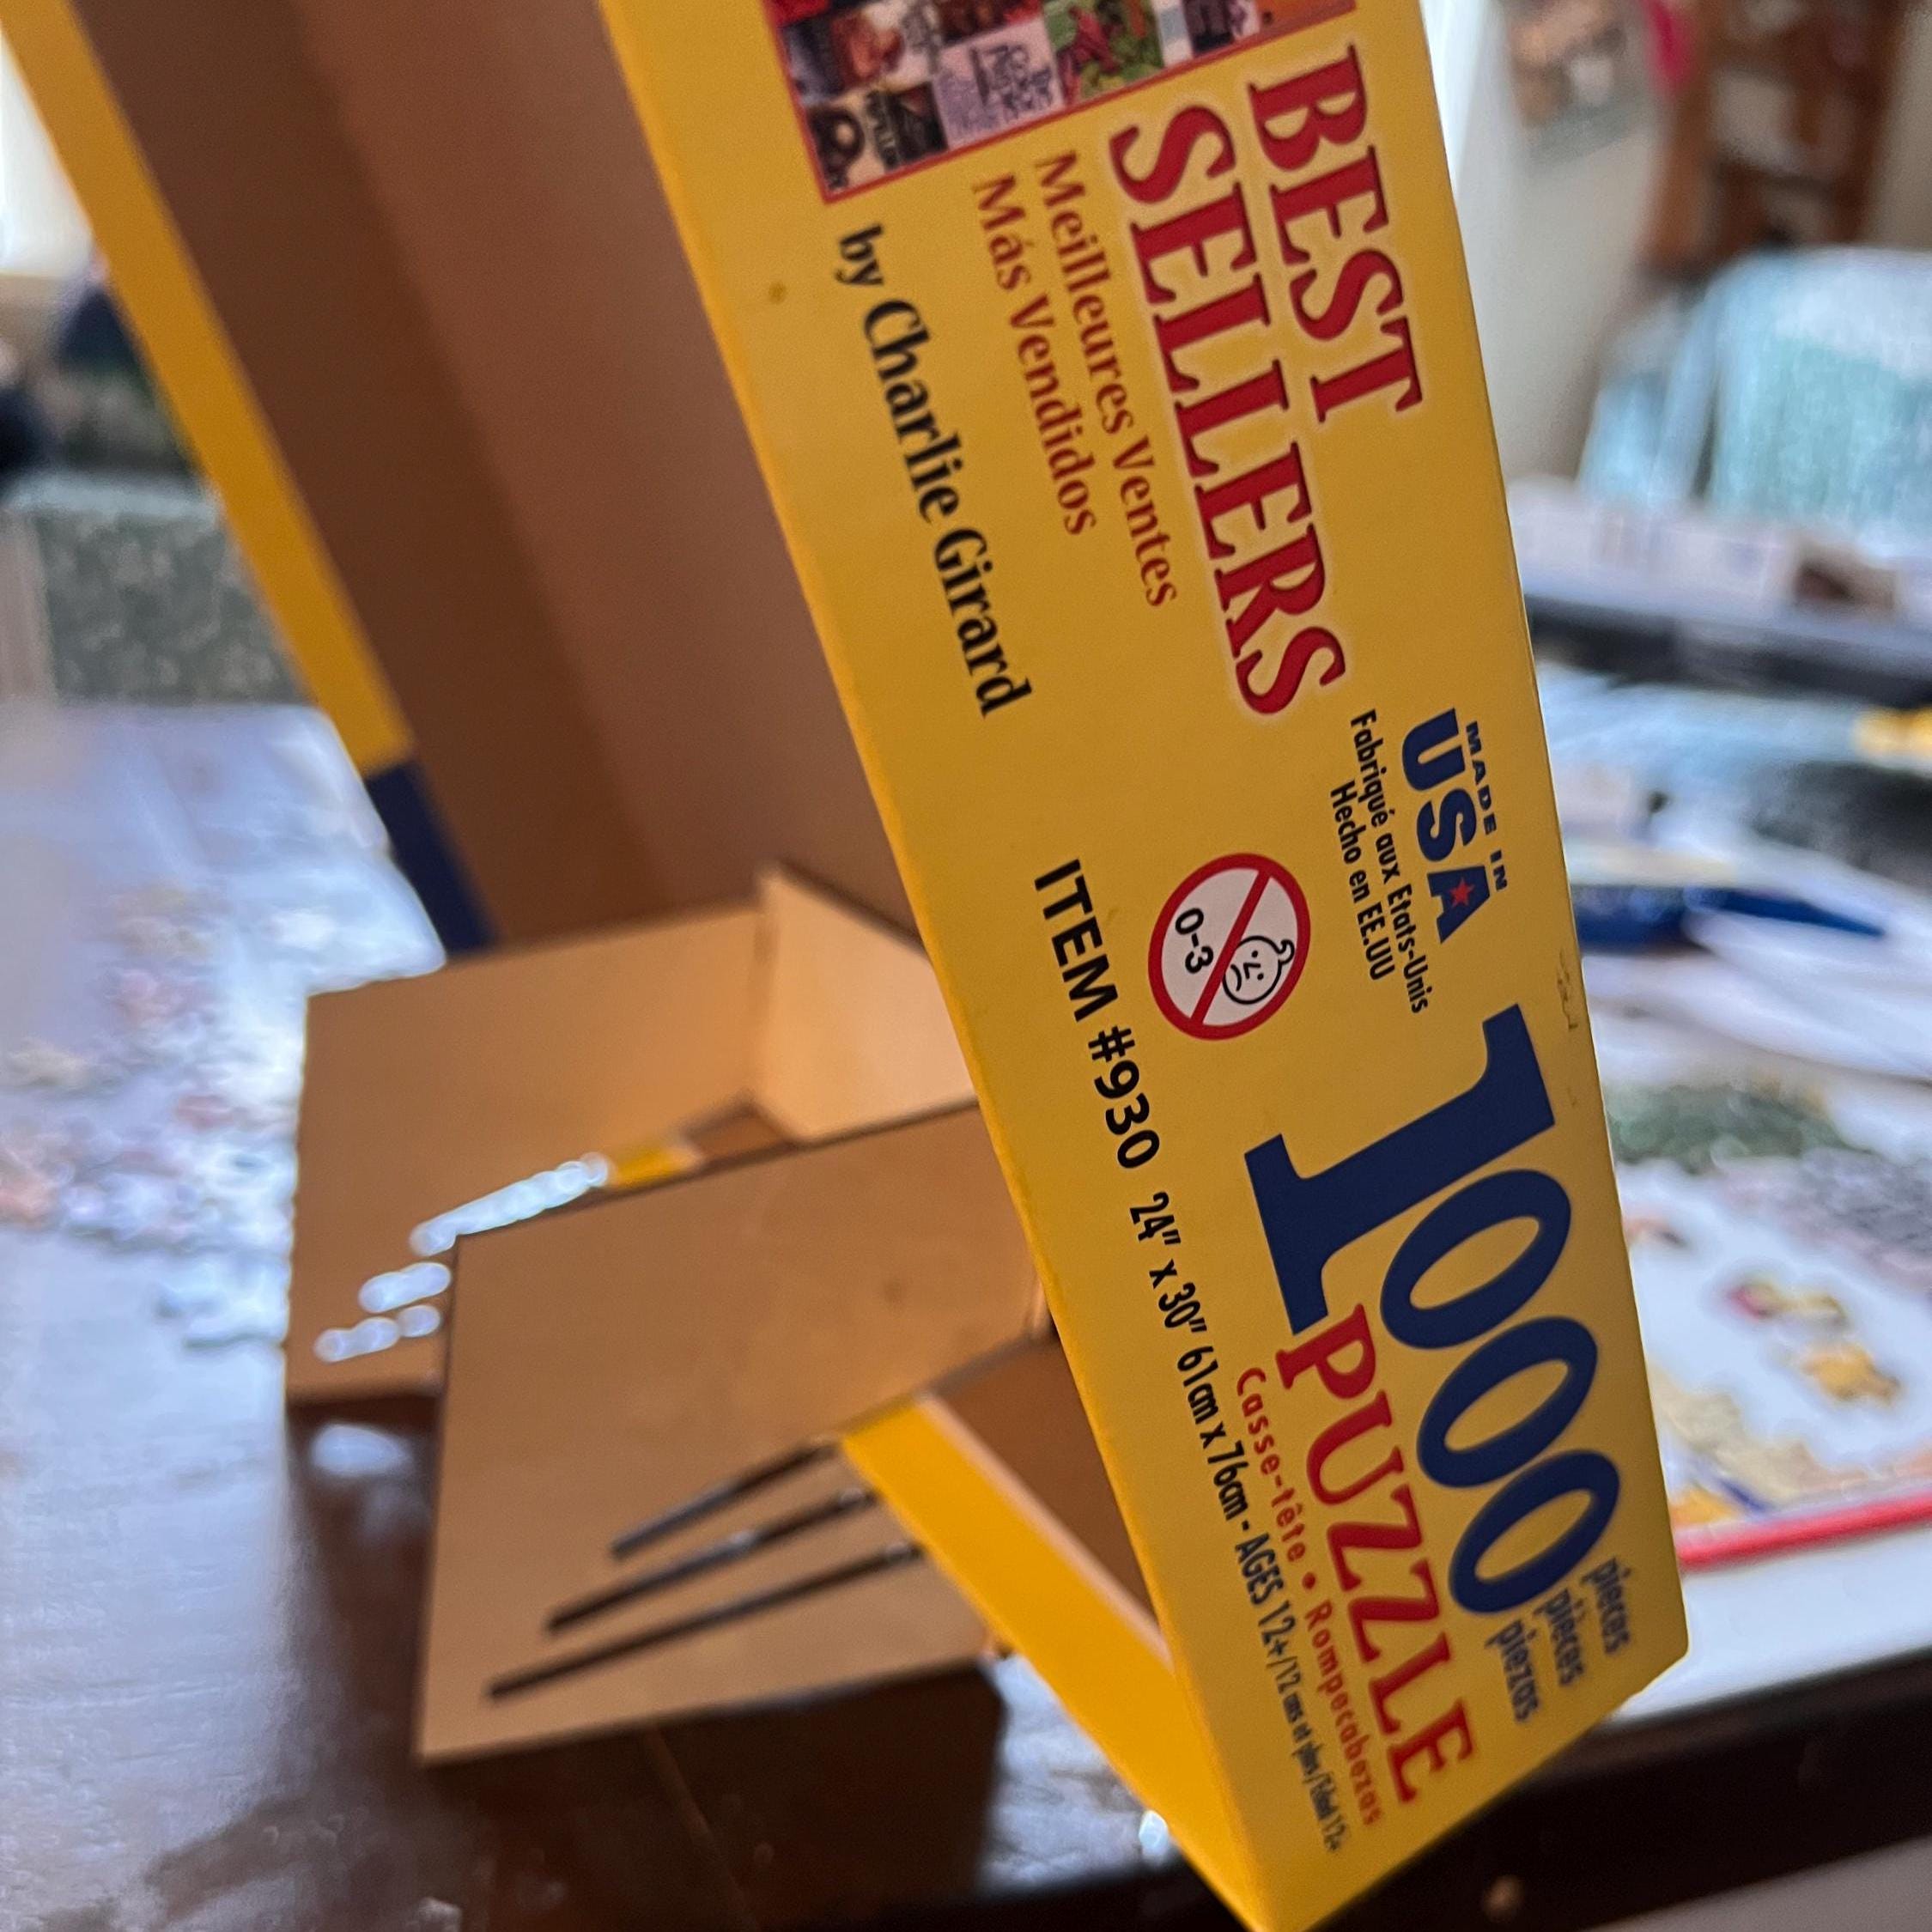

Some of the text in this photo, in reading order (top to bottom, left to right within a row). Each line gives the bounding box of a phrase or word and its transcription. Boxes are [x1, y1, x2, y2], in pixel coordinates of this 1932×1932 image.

[1247, 44, 1423, 423] BEST
[972, 174, 1031, 292] Más
[1009, 294, 1097, 537] Vendidos
[1033, 149, 1177, 608] Meilleures Ventes
[1109, 104, 1346, 715] SELLERS
[835, 222, 1033, 720] by Charlie Girard
[1330, 779, 1395, 981] Hecho en EE.UU
[1351, 708, 1433, 1014] Fabriqué aux Etats-Unis
[1401, 708, 1491, 945] USA
[1466, 720, 1508, 892] MADE IN
[1035, 858, 1160, 1170] ITEM #930
[1175, 908, 1215, 974] 0-3
[1149, 1259, 1178, 1290] x
[1243, 1003, 1620, 1616] 1000
[1176, 1346, 1219, 1425] 61cm
[1200, 1421, 1227, 1450] x
[1207, 1439, 1249, 1522] 76cm
[1236, 1366, 1306, 1563] Casse-tête
[1235, 1532, 1284, 1607] AGES
[1274, 1303, 1478, 1805] PUZZLE
[1579, 1558, 1631, 1655] pieces
[1484, 1619, 1539, 1722] piezas
